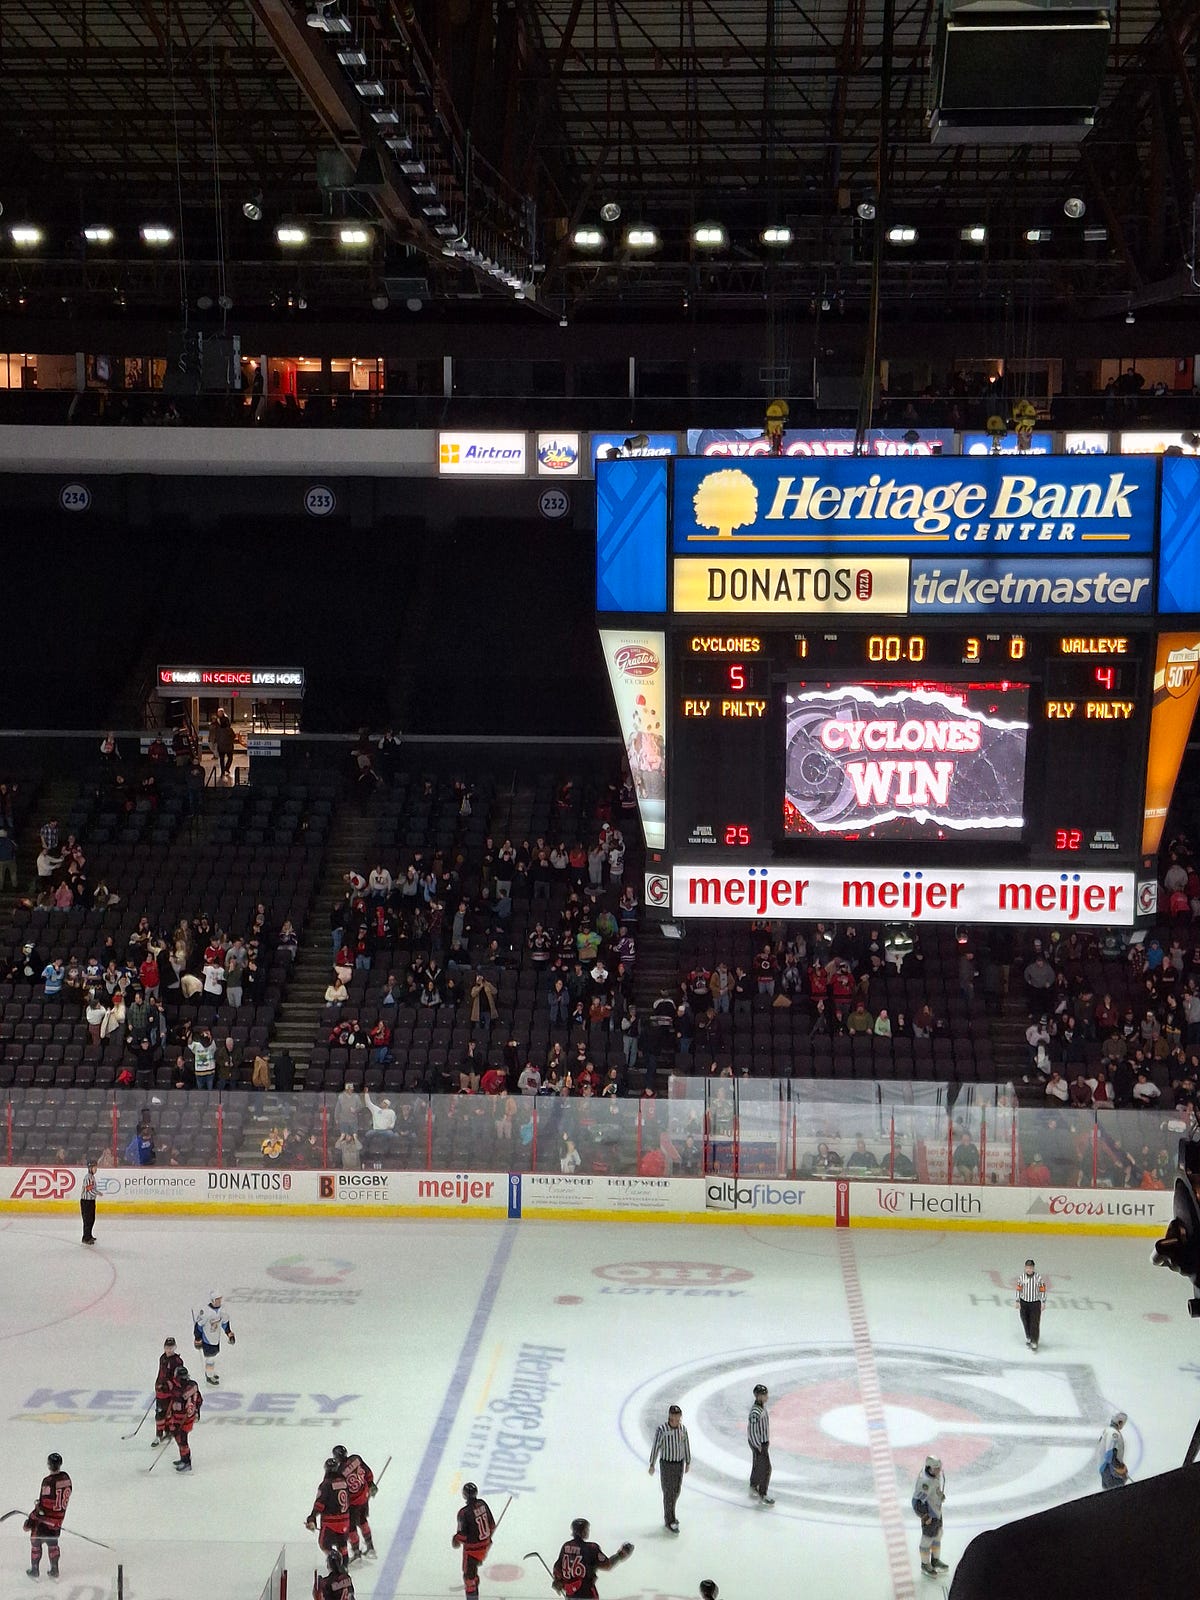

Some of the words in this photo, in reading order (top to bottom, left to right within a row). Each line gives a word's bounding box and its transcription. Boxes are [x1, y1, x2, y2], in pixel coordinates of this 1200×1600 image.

[465, 445, 522, 459] Airtron
[64, 492, 86, 505] 234
[309, 495, 331, 508] 233
[543, 497, 565, 510] 232
[764, 472, 987, 533] Heritage
[992, 471, 1139, 520] Bank
[955, 524, 1076, 541] CENTER
[706, 568, 852, 602] DONATOS
[858, 570, 872, 600] PIZZA
[913, 568, 1150, 604] ticketmaster
[691, 637, 761, 654] CYCLONES
[801, 640, 808, 658] 1
[868, 637, 925, 662] 00.0
[966, 638, 979, 659] 3
[1010, 639, 1025, 659] 0
[1062, 637, 1128, 654] WALLEYE
[202, 672, 213, 683] IN
[213, 672, 251, 684] SCIENCE
[251, 673, 275, 684] LIVES
[730, 666, 746, 691] 5
[1095, 667, 1115, 691] 4
[684, 701, 711, 718] PLY
[721, 701, 767, 718] PNLTY
[1047, 702, 1074, 719] PLY
[1086, 702, 1133, 719] PNLTY
[820, 719, 982, 752] CYCLONES
[846, 760, 955, 806] WIN
[725, 827, 749, 845] 25
[1056, 831, 1081, 850] 32
[688, 868, 810, 915] meijer
[842, 870, 965, 918] meijer
[999, 873, 1123, 920] meijer
[10, 1168, 76, 1199] ADP
[124, 1175, 196, 1188] performance
[207, 1172, 281, 1190] DONATOS
[338, 1175, 389, 1187] BIGGBY
[418, 1173, 495, 1204] meijer
[531, 1177, 594, 1186] HOLLYWOOD
[338, 1190, 389, 1200] COFFEE
[707, 1181, 806, 1209] altafiber
[909, 1191, 982, 1214] Health
[1048, 1194, 1105, 1217] Coors
[1107, 1203, 1156, 1217] LIGHT
[598, 1286, 746, 1298] LOTTERY
[486, 1342, 566, 1431] Heritage
[22, 1387, 364, 1414] KESEY
[482, 1429, 547, 1498] Bank
